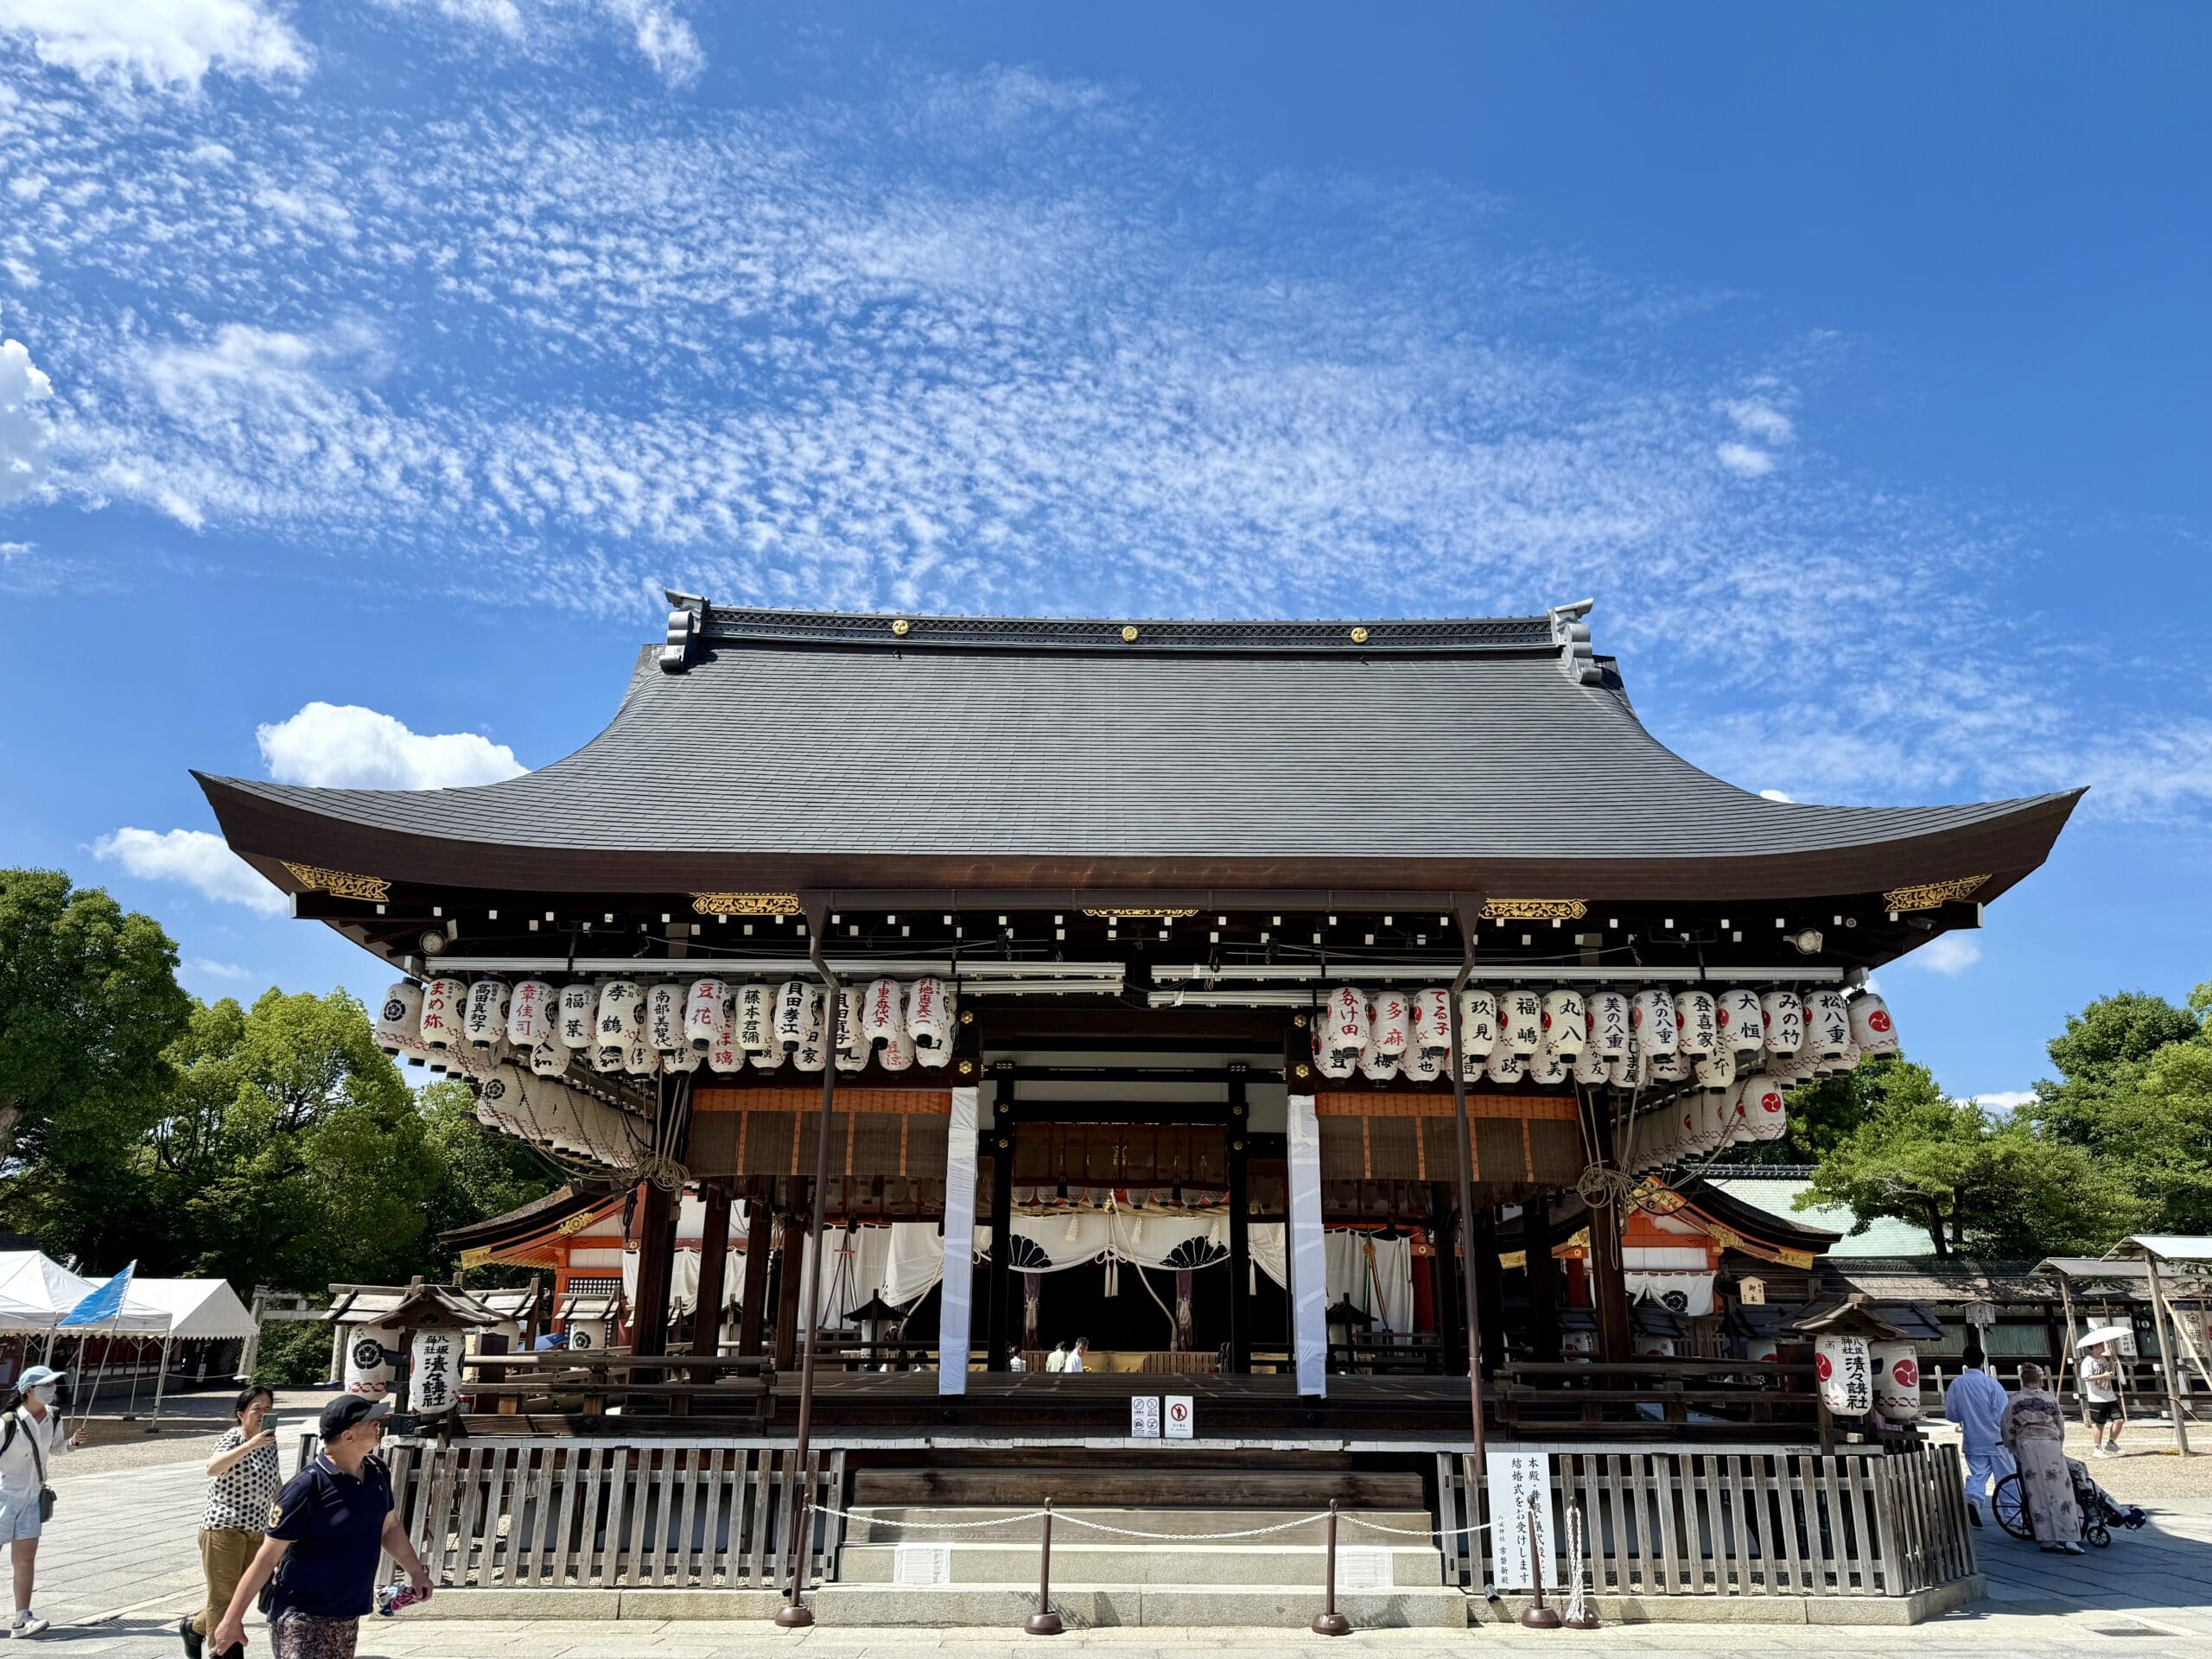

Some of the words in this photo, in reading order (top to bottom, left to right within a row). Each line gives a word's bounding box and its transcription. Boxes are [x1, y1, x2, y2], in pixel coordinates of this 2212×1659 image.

[423, 982, 445, 1029] まめ弥
[564, 993, 585, 1038] 福葉
[601, 984, 627, 1034] 孝鶴
[692, 982, 715, 1025] 豆花
[779, 982, 804, 1035] 貝田孝江
[1383, 1001, 1404, 1046] 多麻
[1430, 991, 1450, 1036] てる子
[1471, 1000, 1493, 1042] 玖見
[1516, 997, 1538, 1045] 福嶋
[1560, 998, 1582, 1042] 丸八
[1603, 997, 1625, 1049] 美の八重
[1651, 992, 1674, 1044] 美の八重
[1694, 995, 1713, 1047] 登喜家
[1738, 994, 1761, 1039] 大恒
[1779, 995, 1800, 1046] みの竹
[422, 1355, 449, 1408] 清々講社
[1845, 1356, 1868, 1411] 清々講社
